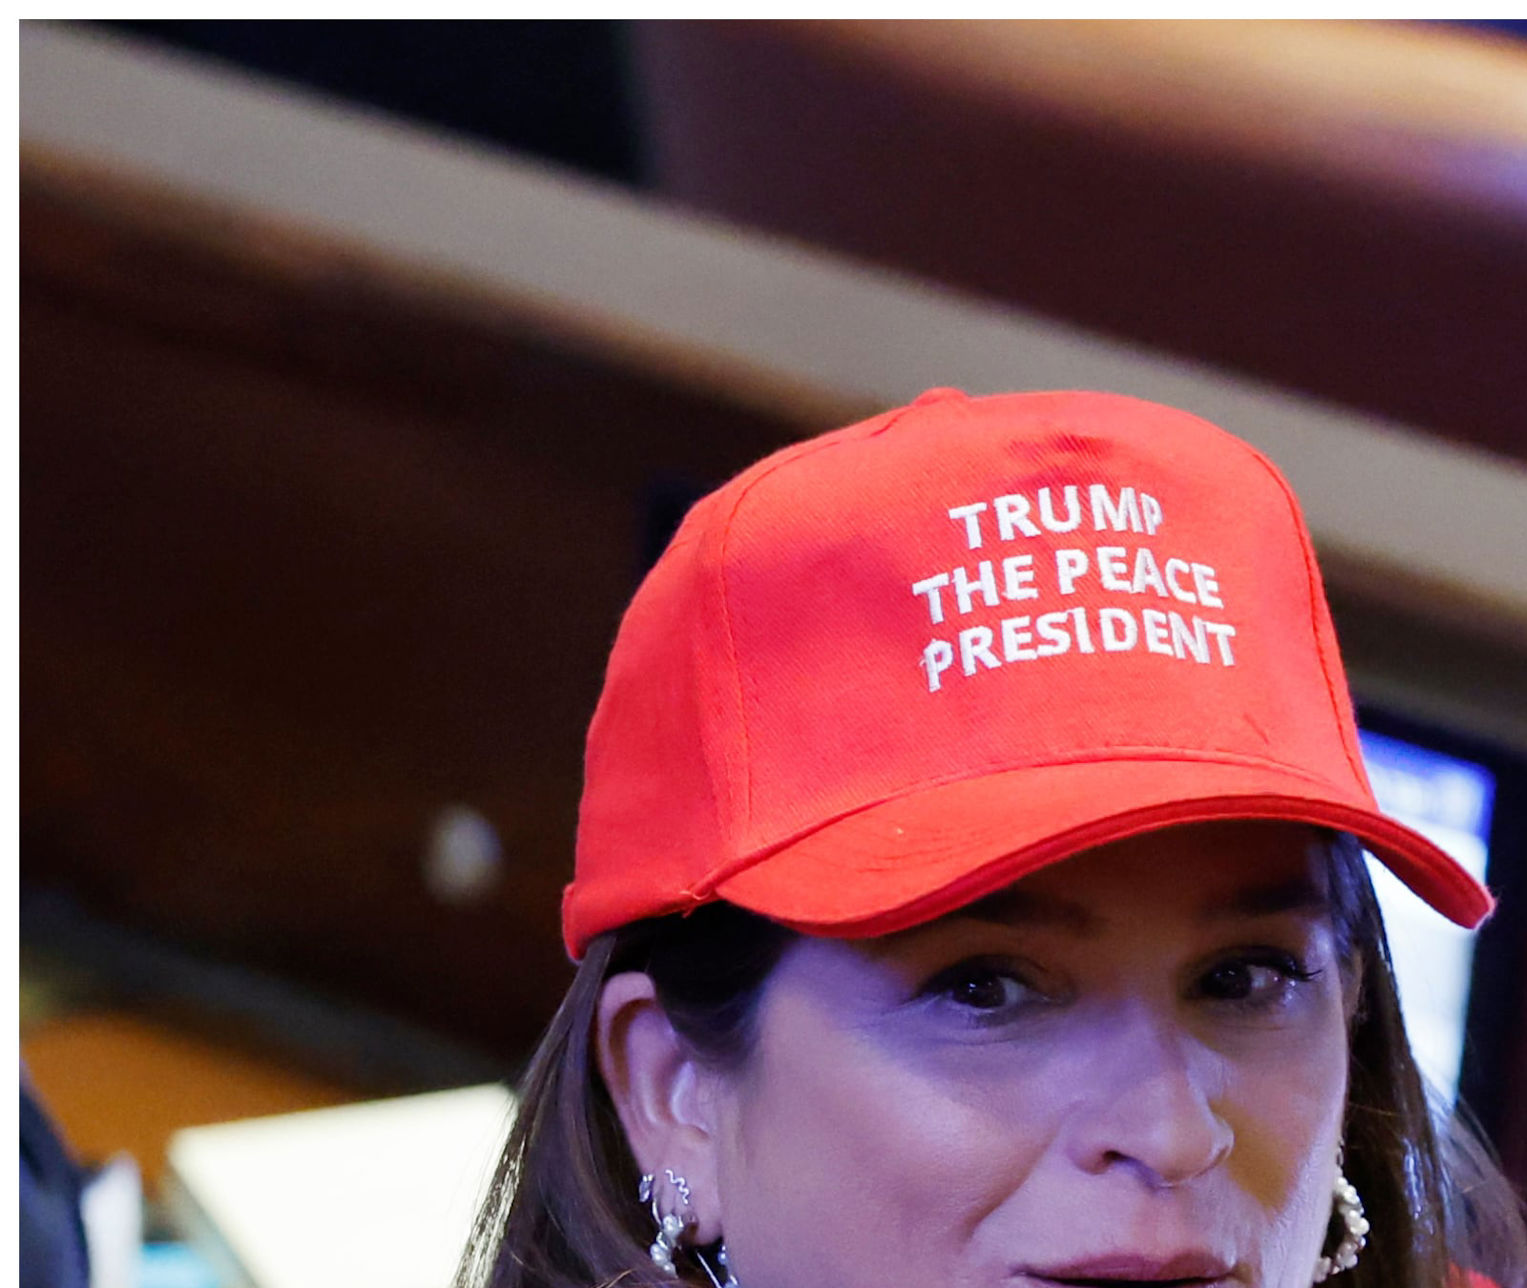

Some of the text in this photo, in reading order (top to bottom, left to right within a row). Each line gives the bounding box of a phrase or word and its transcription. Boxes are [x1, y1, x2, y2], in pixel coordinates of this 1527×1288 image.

[948, 484, 1163, 549] TRUMP
[912, 546, 1224, 623] THE PEACE
[919, 606, 1236, 692] PRESIDENT
